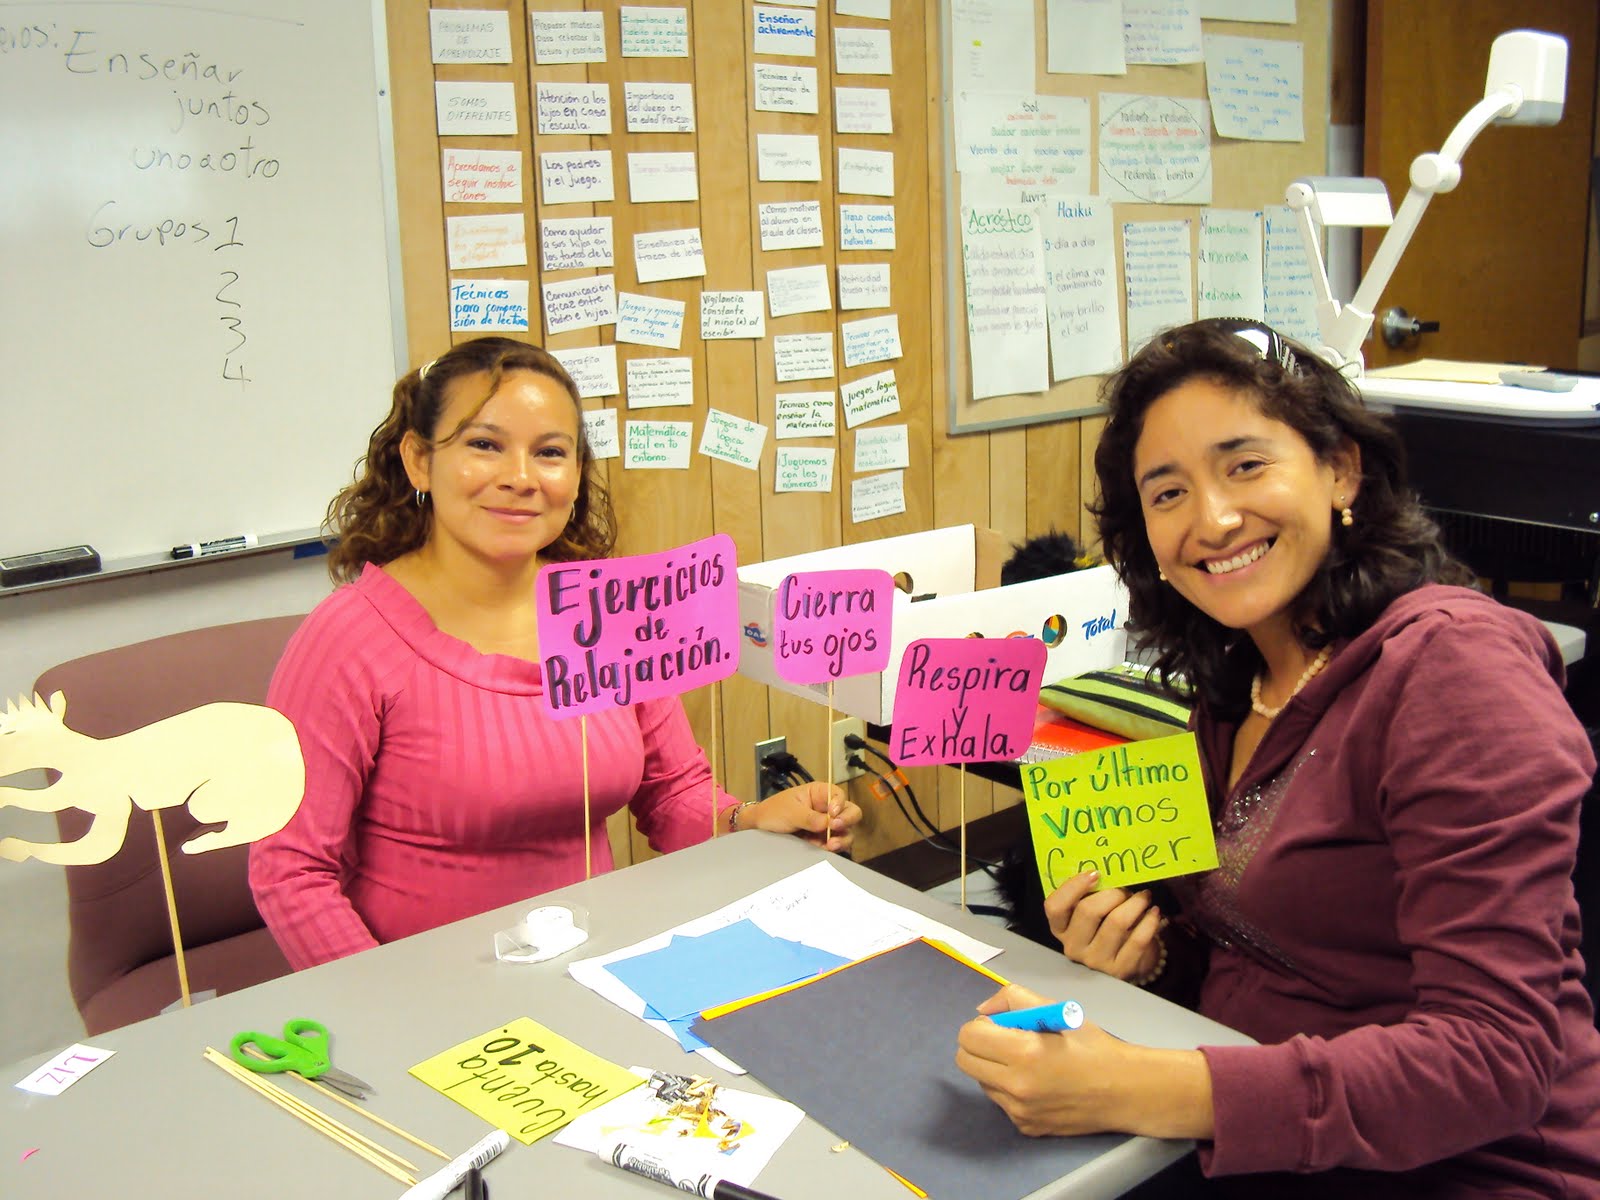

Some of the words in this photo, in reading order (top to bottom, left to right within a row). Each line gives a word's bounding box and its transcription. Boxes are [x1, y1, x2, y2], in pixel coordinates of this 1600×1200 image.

[758, 12, 802, 24] Enseñar
[438, 22, 495, 33] PROBLEMAS
[456, 35, 469, 44] DE
[64, 31, 243, 82] Enseñar
[449, 97, 488, 108] SOMOS
[592, 91, 606, 104] los
[170, 90, 270, 134] juntos
[447, 111, 512, 122] DIFERENTES
[540, 105, 561, 122] hijos
[564, 106, 577, 117] en
[581, 108, 606, 117] casa
[540, 122, 546, 132] y
[448, 155, 500, 177] Aprendamos
[545, 159, 563, 170] Los
[567, 158, 601, 173] padres
[448, 178, 477, 194] seguir
[554, 177, 564, 185] el
[1058, 201, 1093, 218] Haiku
[88, 201, 209, 248] Grupos
[215, 216, 243, 251] 1
[968, 208, 1032, 229] Acróstico
[569, 224, 604, 240] ayudar
[552, 240, 566, 248] sus
[588, 250, 601, 258] de
[216, 271, 241, 308] 2
[451, 283, 509, 301] Técnicas
[702, 294, 744, 308] Vigilancia
[455, 304, 480, 318] para
[702, 305, 744, 315] constante
[481, 317, 492, 325] de
[220, 317, 246, 355] 3
[222, 358, 251, 391] 4
[710, 411, 739, 432] Juegos
[744, 422, 755, 433] de
[812, 410, 821, 418] la
[629, 425, 688, 438] Matemática
[629, 438, 650, 450] fácil
[782, 471, 797, 479] con
[803, 468, 817, 478] los
[548, 552, 725, 648] Ejercicios
[781, 574, 876, 621] Cierra
[635, 613, 670, 642] de
[1082, 608, 1116, 640] Total
[780, 629, 814, 659] tus
[823, 627, 877, 678] ojos
[545, 626, 731, 710] Relajación.
[907, 643, 1031, 709] Respira
[1029, 766, 1077, 801] Por
[1089, 747, 1188, 792] último
[1096, 836, 1109, 847] a
[531, 1060, 609, 1110] hasta
[442, 1054, 566, 1135] Cuenta
